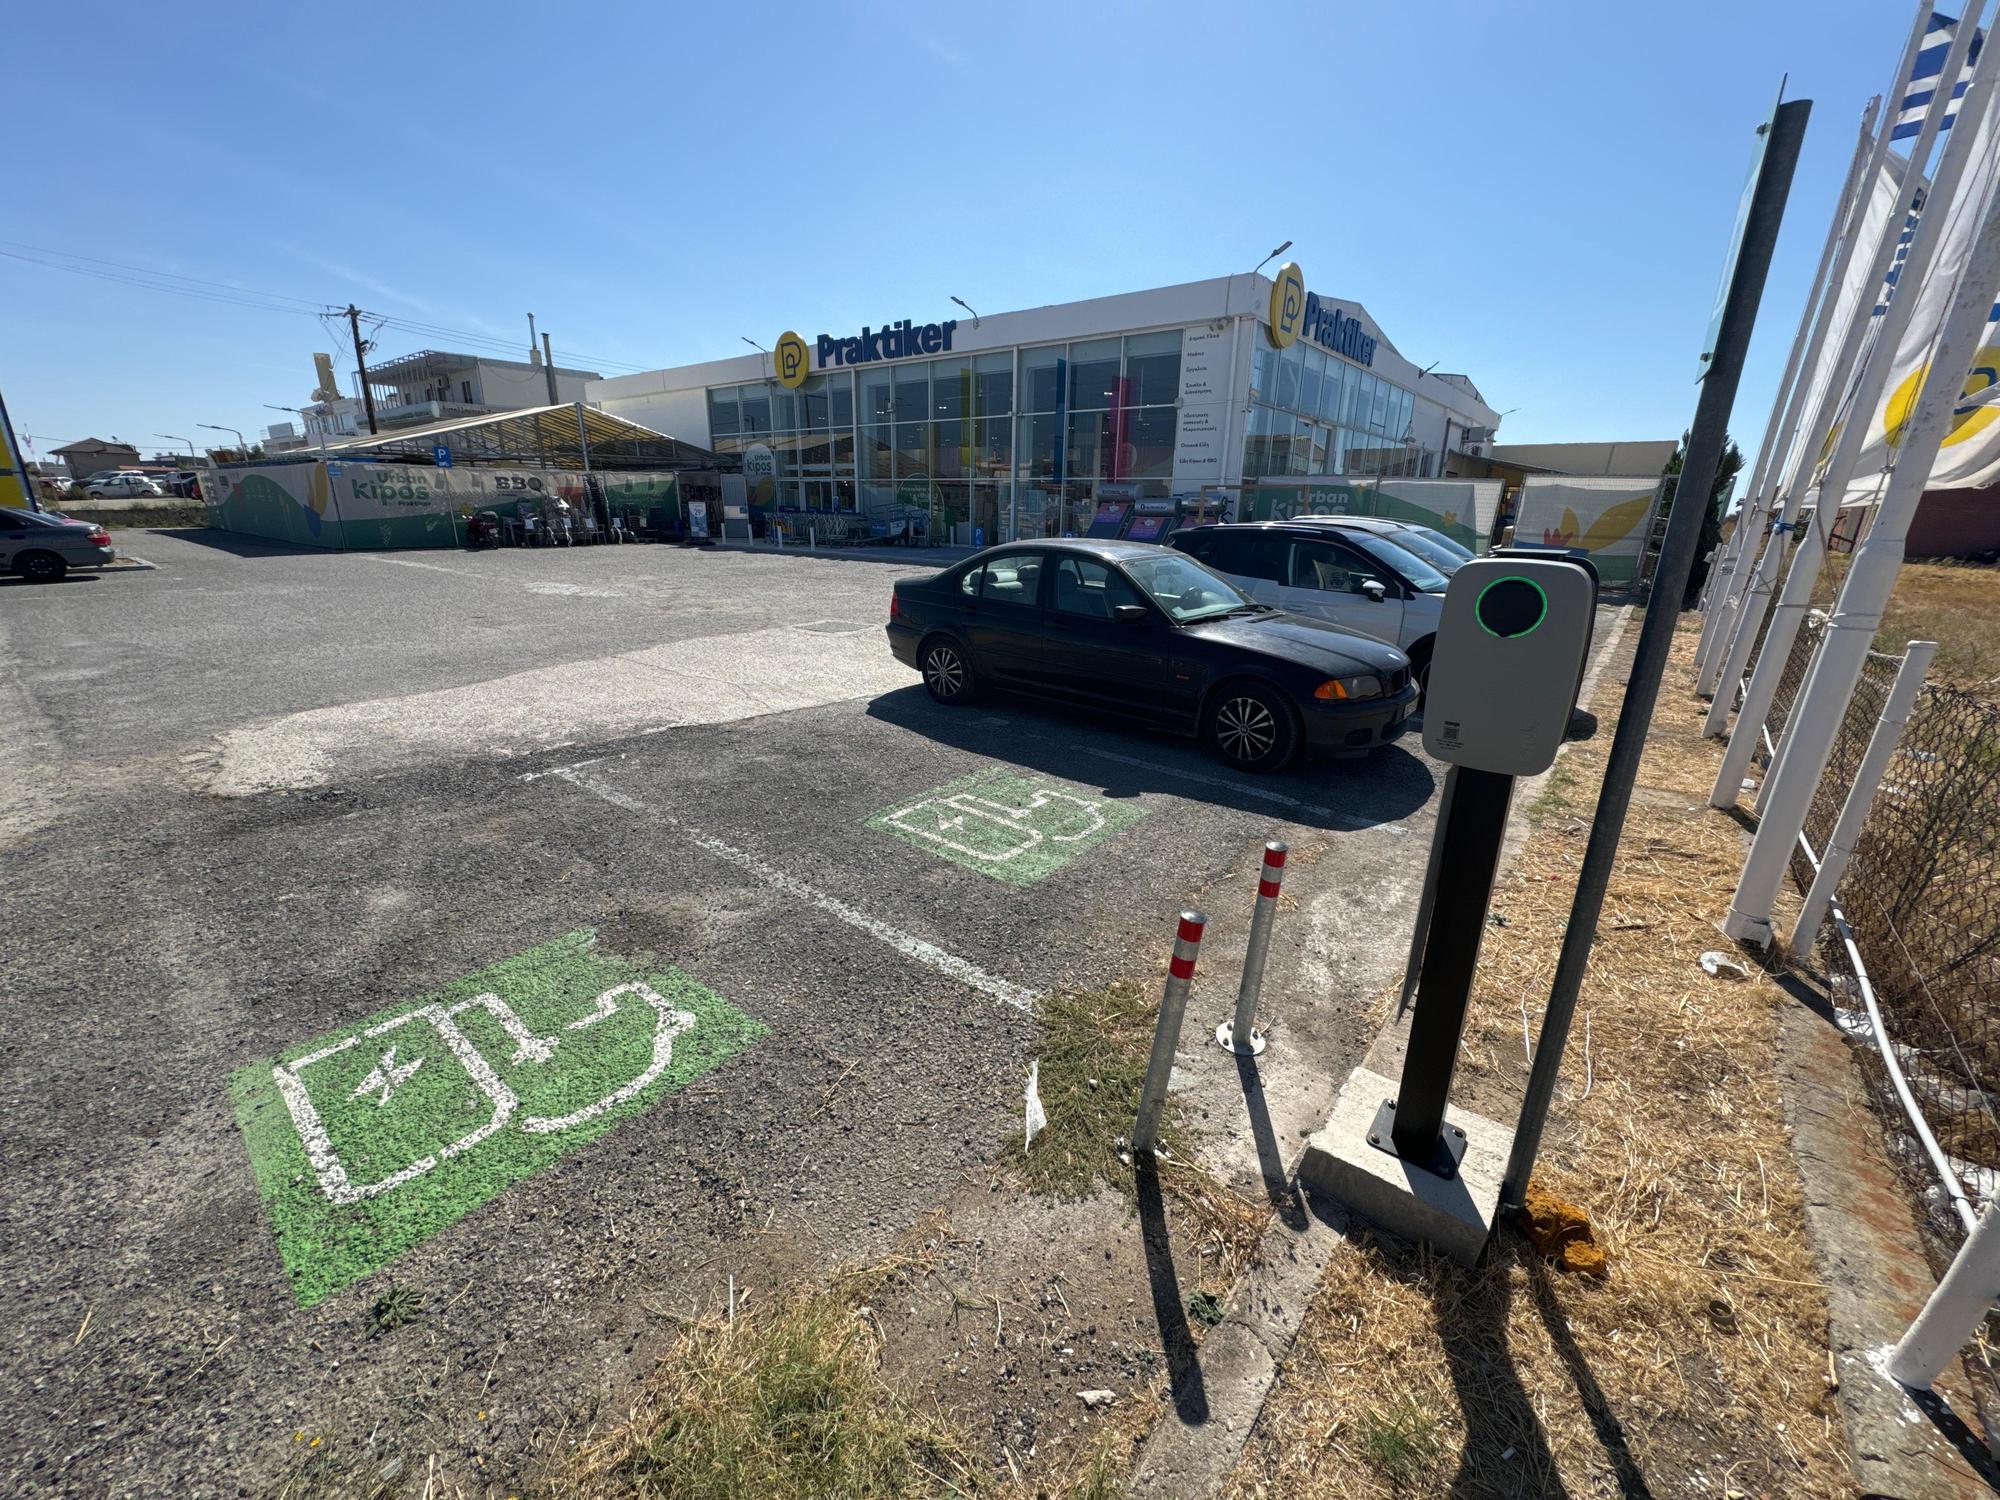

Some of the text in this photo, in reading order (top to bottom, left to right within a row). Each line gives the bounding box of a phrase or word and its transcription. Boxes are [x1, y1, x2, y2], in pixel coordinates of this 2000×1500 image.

[1302, 291, 1377, 367] Praktiker
[817, 319, 957, 368] Praktiker
[437, 448, 446, 459] P
[377, 472, 427, 484] Urban
[494, 476, 542, 492] BBQ
[352, 478, 430, 506] kipos
[1297, 490, 1349, 504] Urban
